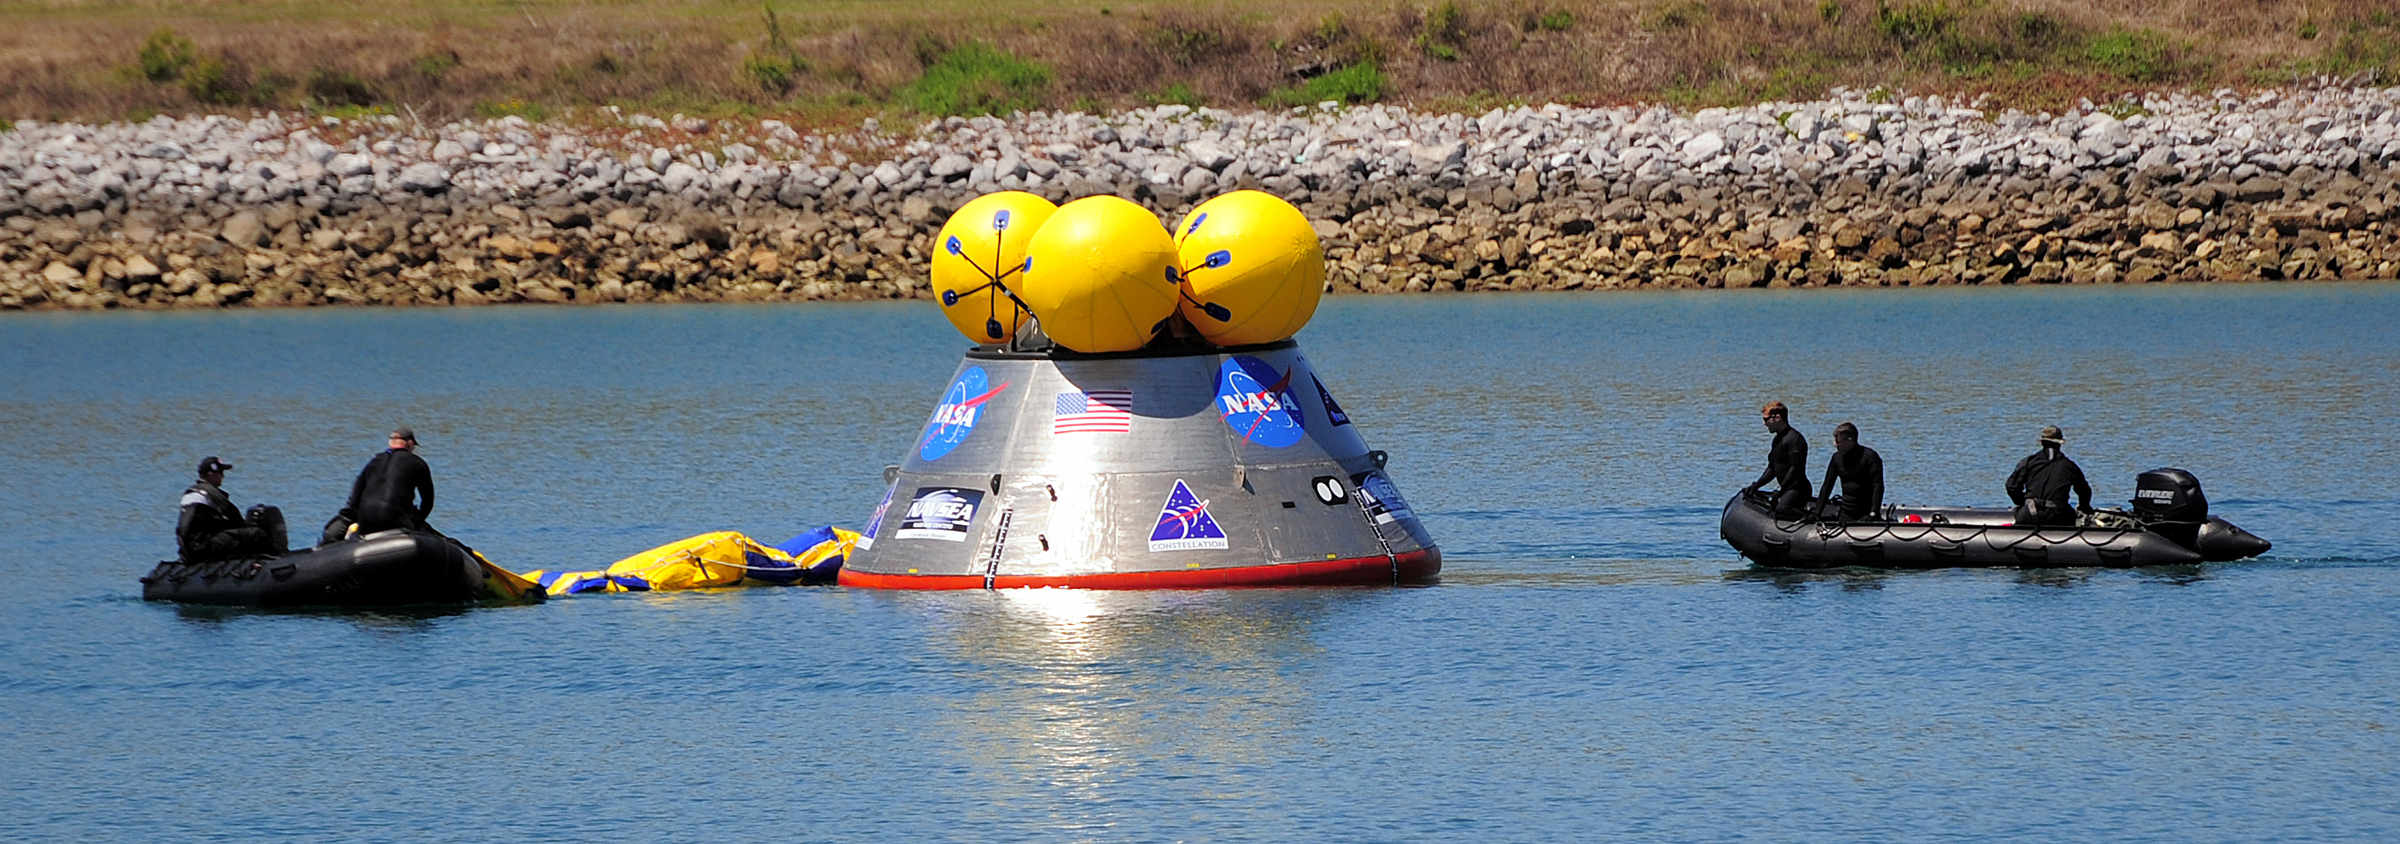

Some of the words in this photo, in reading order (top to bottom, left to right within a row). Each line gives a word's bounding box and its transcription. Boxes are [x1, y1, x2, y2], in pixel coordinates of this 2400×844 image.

[1222, 392, 1299, 415] NASA
[932, 403, 976, 428] NASA
[906, 501, 974, 520] NAVSEA
[1151, 540, 1226, 551] CONSTELLATION
